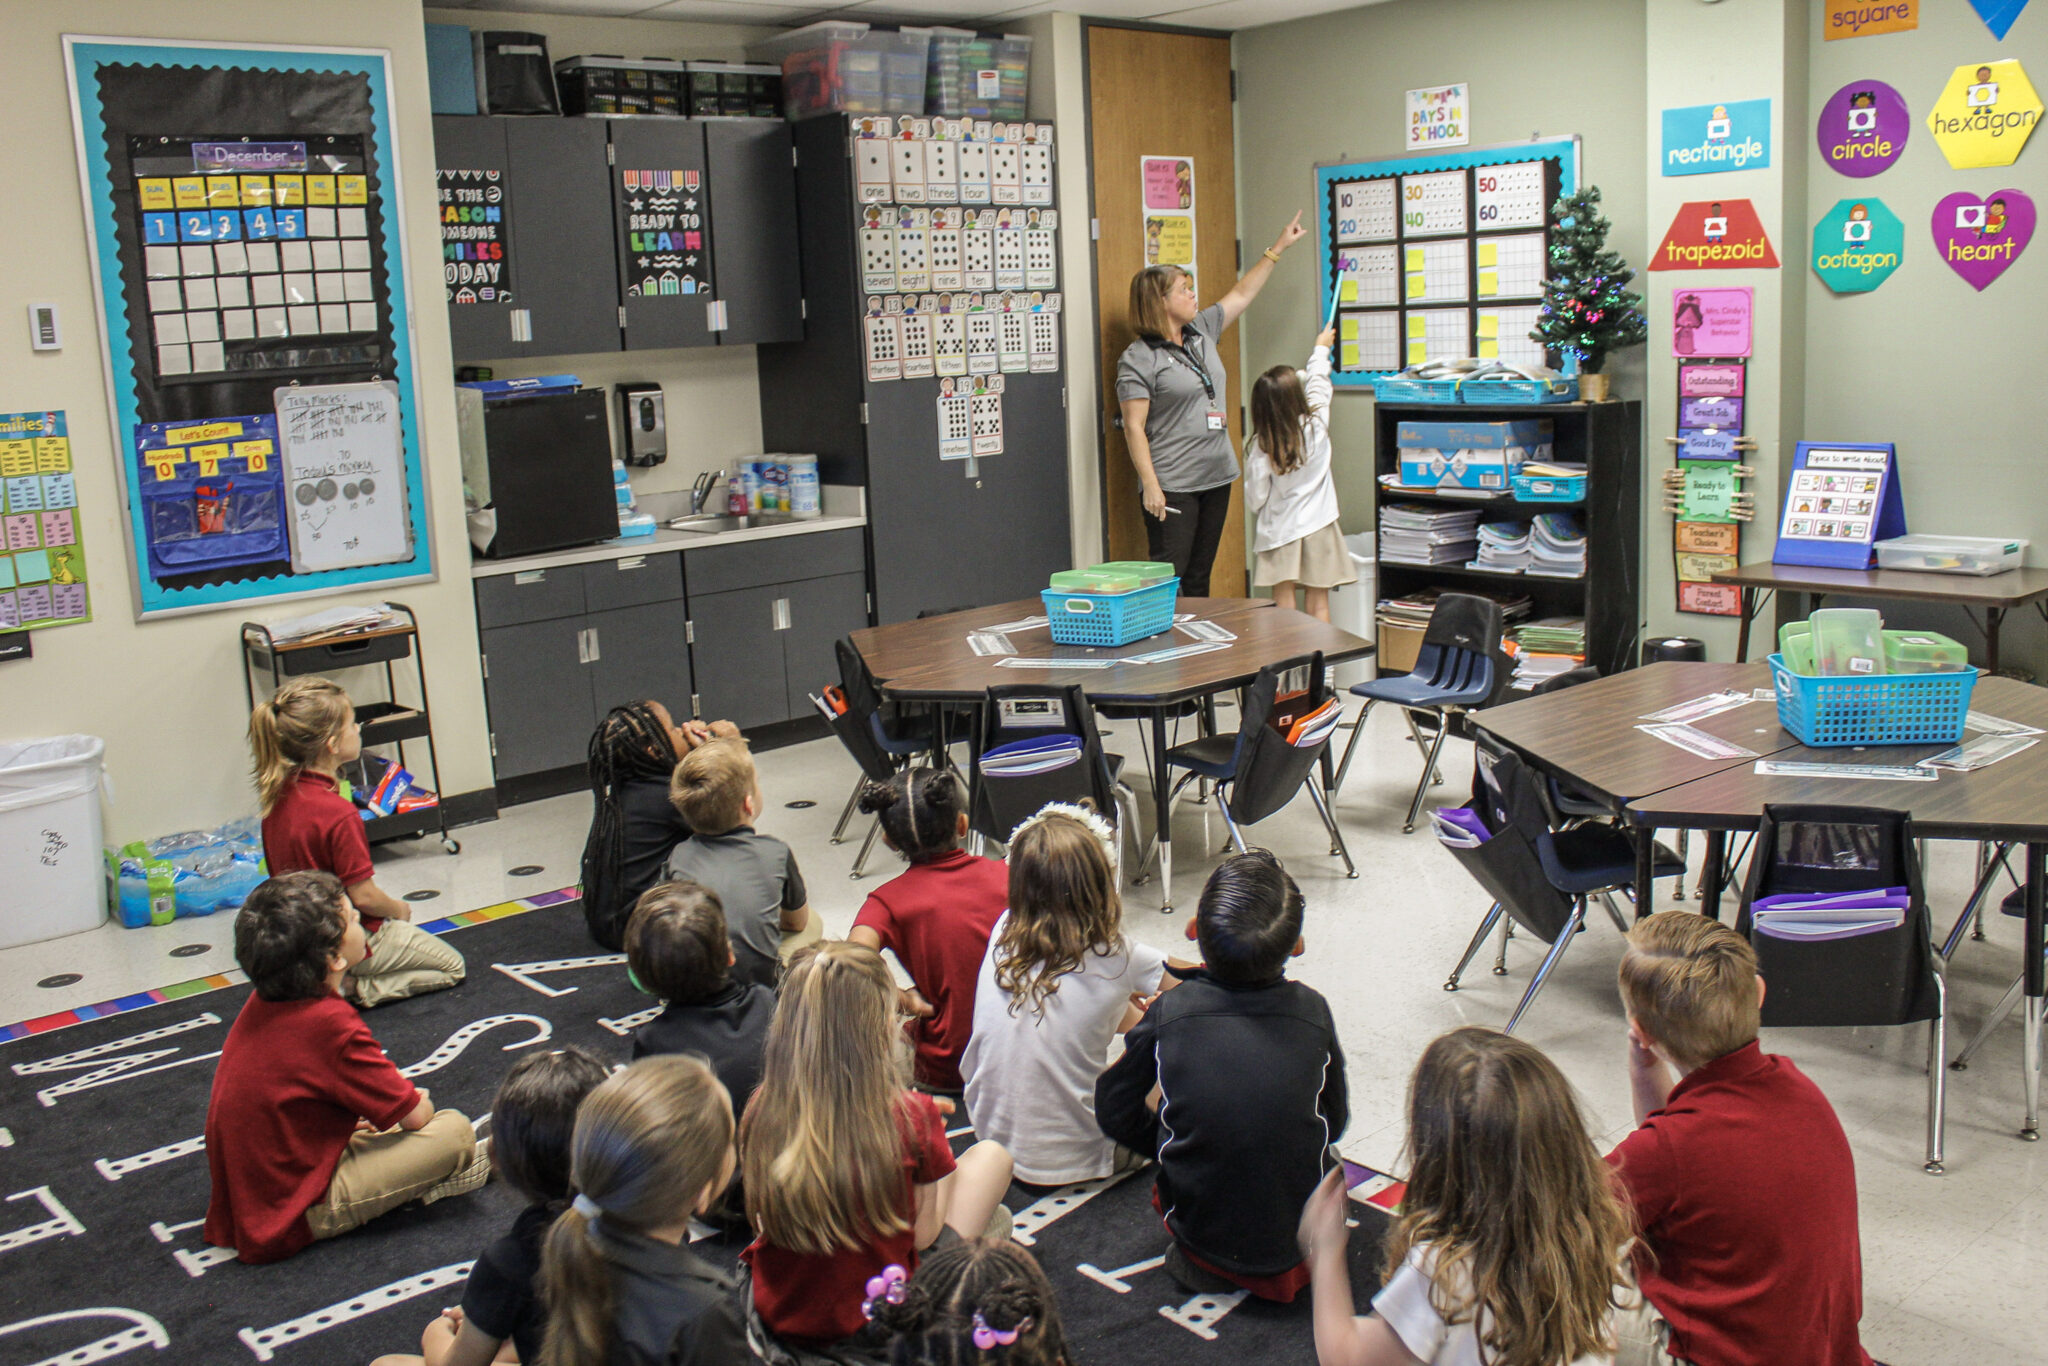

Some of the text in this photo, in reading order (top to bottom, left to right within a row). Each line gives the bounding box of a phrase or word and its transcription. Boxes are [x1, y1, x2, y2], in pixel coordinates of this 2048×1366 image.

[1832, 4, 1909, 33] square
[1412, 106, 1463, 125] DAYS IN
[879, 121, 885, 135] 1
[917, 123, 924, 136] 2
[950, 124, 957, 136] 3
[1934, 109, 2036, 138] hexagon
[1011, 127, 1018, 139] 5
[1411, 123, 1463, 142] SCHOOL
[1668, 136, 1763, 167] rectangle
[1831, 135, 1893, 160] circle
[214, 147, 288, 163] December
[1479, 176, 1497, 192] 50
[456, 189, 484, 202] THE
[865, 187, 885, 199] one
[900, 188, 920, 199] two
[929, 186, 956, 199] three
[998, 187, 1015, 200] five
[1029, 189, 1043, 199] six
[1405, 186, 1423, 201] 30
[1341, 193, 1353, 208] 10
[885, 212, 892, 224] 7
[918, 212, 925, 224] 8
[950, 212, 957, 224] 9
[1014, 213, 1023, 225] 11
[1044, 213, 1054, 226] 12
[1405, 212, 1424, 227] 40
[1479, 205, 1497, 221] 60
[189, 218, 201, 233] 2
[218, 216, 231, 233] 3
[254, 213, 266, 230] 4
[285, 215, 296, 232] 5
[629, 214, 700, 230] READY TO
[982, 214, 993, 226] 10
[154, 219, 165, 237] 1
[1340, 219, 1357, 235] 20
[631, 232, 701, 252] LEARN
[1666, 237, 1765, 267] trapezoid
[1948, 237, 2016, 261] heart
[1817, 248, 1897, 275] octagon
[445, 262, 502, 285] ODAY
[938, 274, 957, 286] nine
[971, 274, 986, 286] ten
[867, 276, 894, 286] seven
[902, 274, 926, 290] eight
[888, 301, 898, 312] 13
[921, 300, 933, 311] 14
[956, 298, 966, 309] 15
[986, 298, 997, 309] 16
[1018, 296, 1028, 308] 17
[1710, 318, 1741, 327] Superstar
[1711, 329, 1740, 337] Behavior
[959, 380, 970, 392] 19
[990, 378, 1001, 390] 20
[1688, 376, 1735, 388] Outstanding
[1693, 407, 1729, 418] Great Job
[180, 425, 230, 441] Let's Count
[1691, 438, 1727, 450] Good Day
[148, 452, 183, 461] Hundreds
[252, 455, 264, 469] 0
[160, 462, 171, 477] 0
[205, 459, 215, 473] 7
[1693, 480, 1726, 492] Ready to
[1697, 492, 1719, 501] Learn
[1690, 526, 1724, 538] Teacher's
[1694, 538, 1718, 547] Choice
[1697, 588, 1722, 597] Parent
[1695, 598, 1724, 608] Contact
